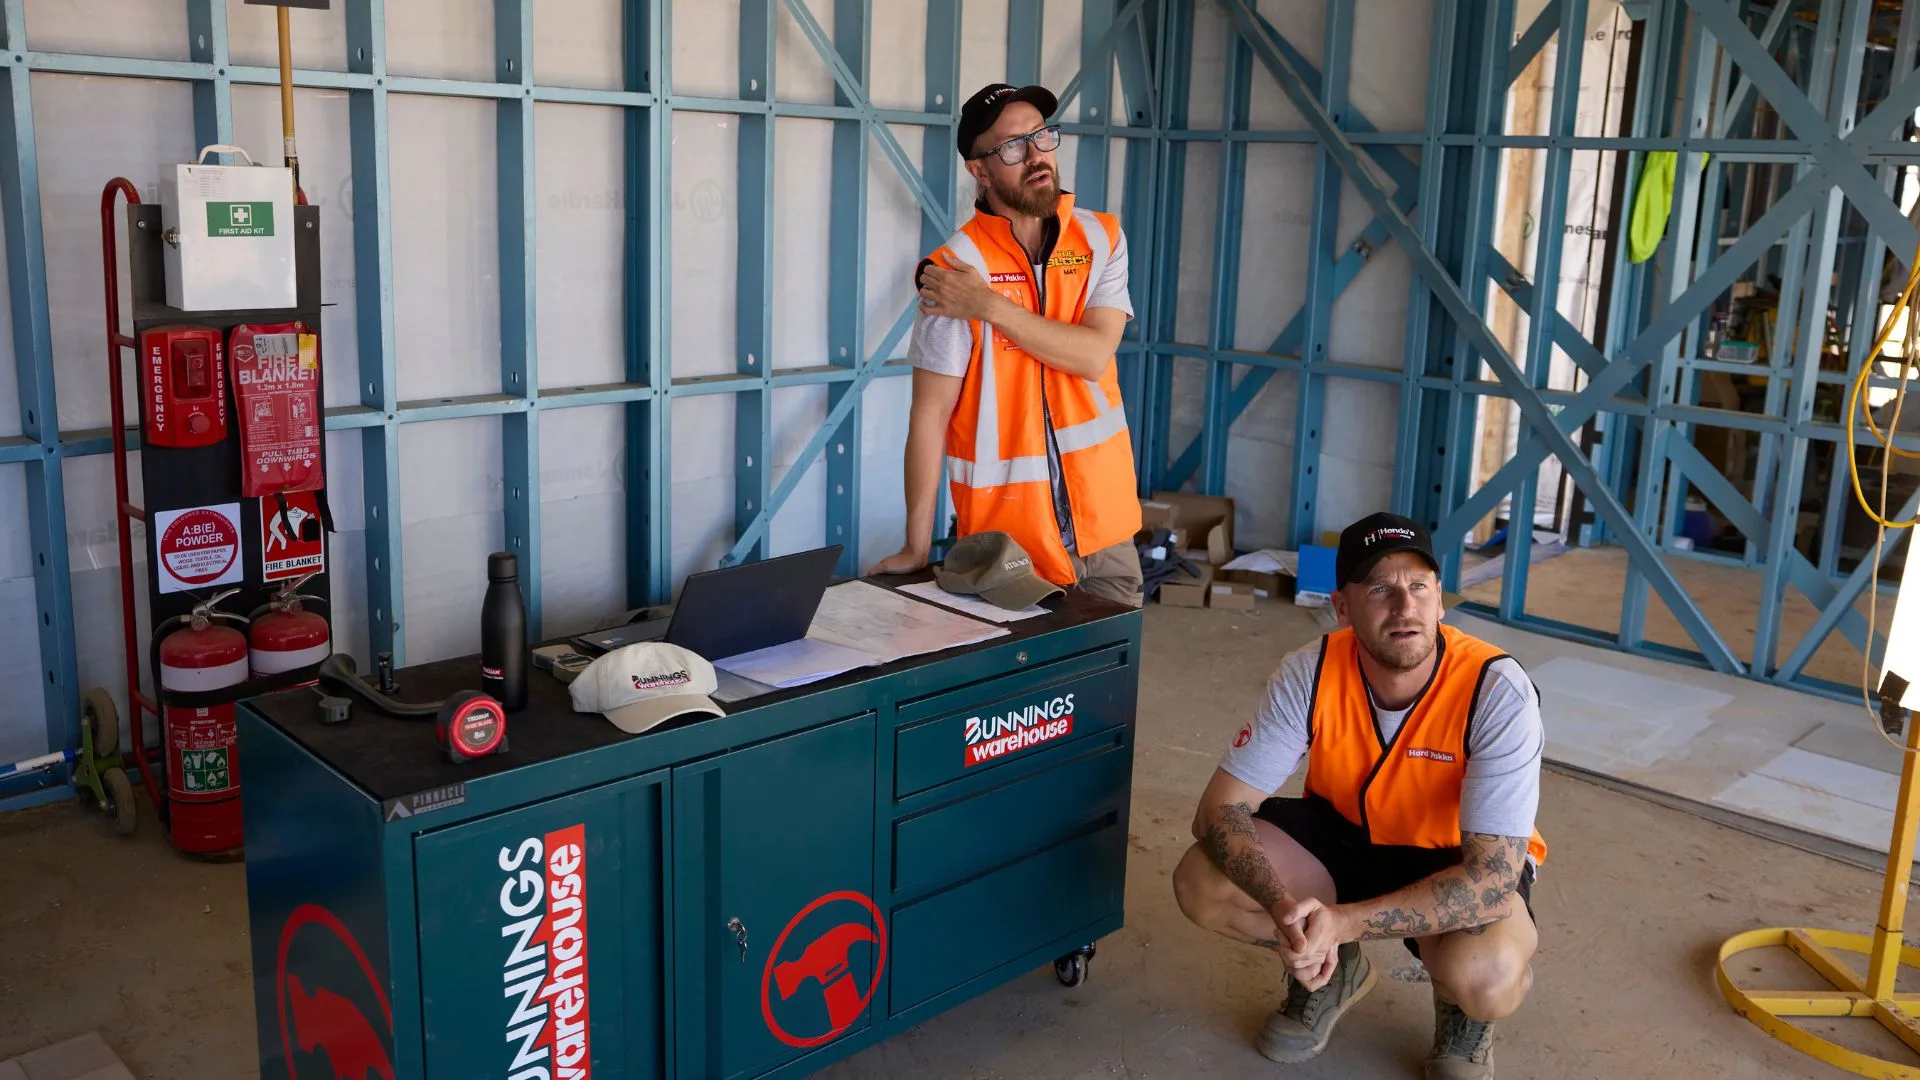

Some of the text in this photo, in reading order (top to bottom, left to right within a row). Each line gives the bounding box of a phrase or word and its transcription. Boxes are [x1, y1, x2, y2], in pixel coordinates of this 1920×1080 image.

[1047, 254, 1093, 268] BLOCK
[1004, 274, 1026, 282] Yakka
[257, 355, 297, 370] FIRE
[152, 346, 164, 432] EMERGENCY
[216, 343, 225, 426] EMERGENCY
[256, 453, 317, 465] DOWNWARDS
[262, 447, 310, 458] PULL TABS
[182, 521, 216, 536] A:B(E)
[176, 532, 224, 548] POWDER
[265, 556, 322, 572] FIRE BLANKET
[631, 670, 688, 684] BUNNINGS
[638, 678, 688, 689] warehouse
[467, 713, 490, 723] TROJAN
[964, 693, 1075, 746] BUNNINGS
[972, 718, 1069, 762] warehouse
[1408, 749, 1453, 762] Hard Yakka
[412, 783, 465, 807] PINNACLE
